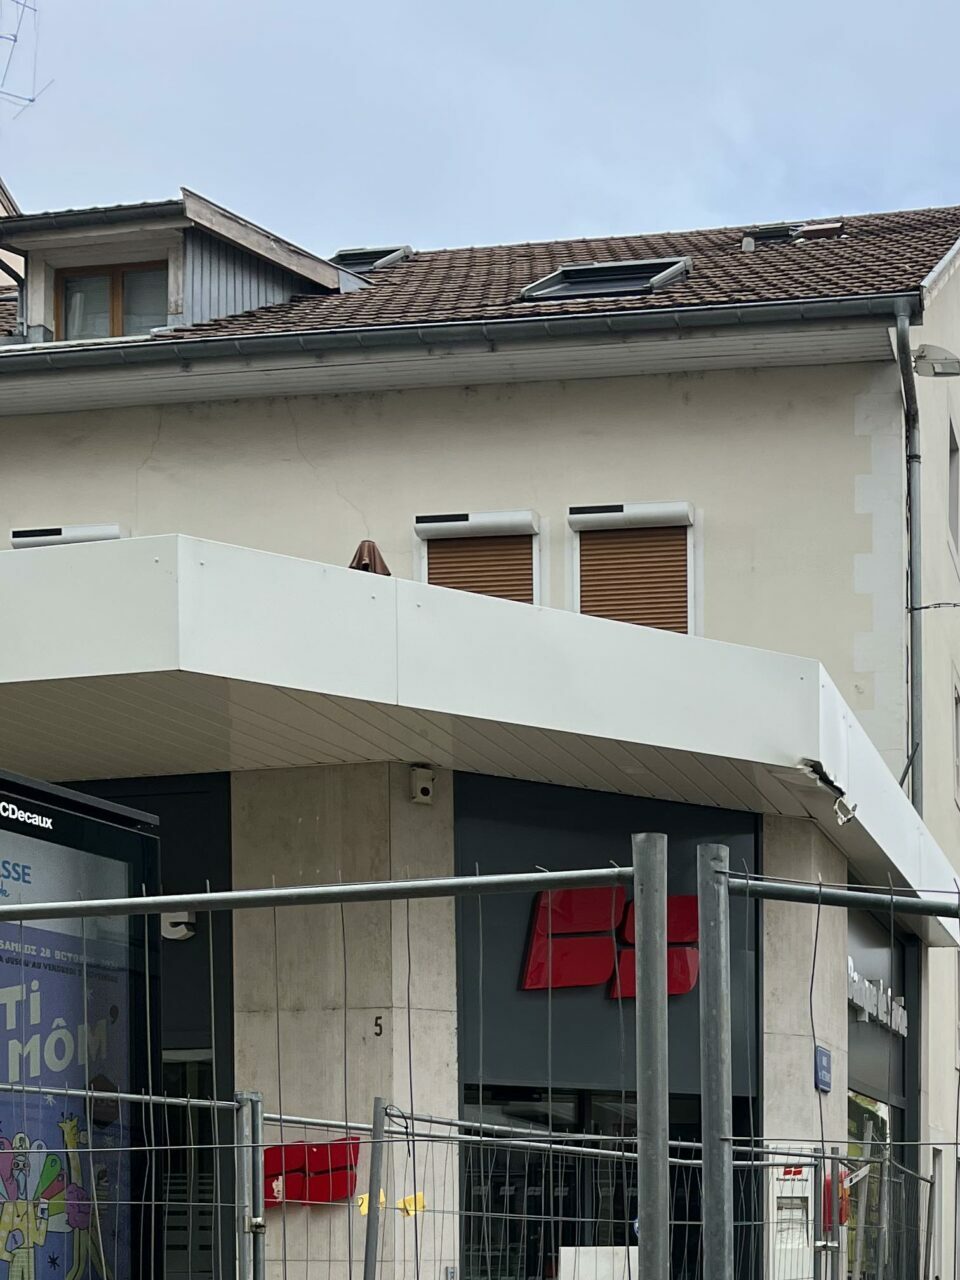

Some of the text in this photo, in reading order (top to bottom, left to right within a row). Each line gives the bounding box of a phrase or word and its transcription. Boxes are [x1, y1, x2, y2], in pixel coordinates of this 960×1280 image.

[0, 802, 54, 830] CDecaux
[0, 860, 32, 885] SSE
[374, 1015, 383, 1037] 5
